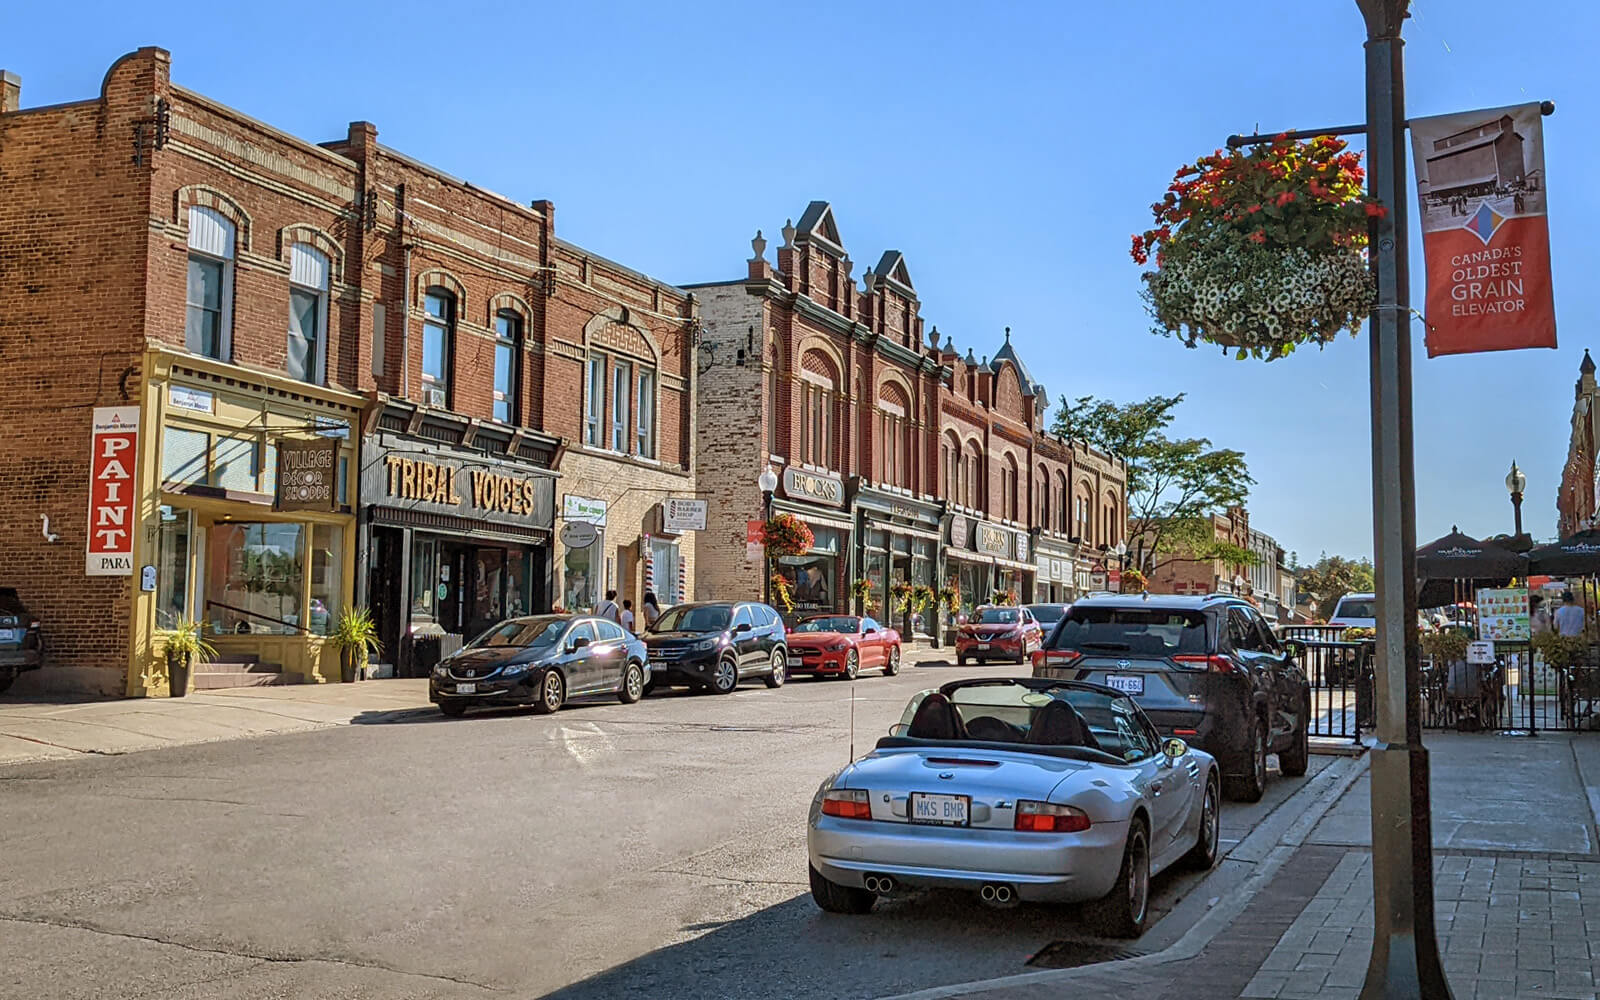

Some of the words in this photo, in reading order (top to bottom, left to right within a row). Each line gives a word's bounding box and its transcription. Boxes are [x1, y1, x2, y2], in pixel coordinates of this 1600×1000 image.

[1451, 246, 1522, 267] CANADA'S
[1451, 261, 1522, 282] OLDEST
[1451, 279, 1524, 301] GRAIN
[1452, 299, 1525, 317] ELEVATOR
[283, 449, 333, 472] VILLAGE
[96, 437, 131, 550] PAINT
[285, 485, 330, 500] SHOPPE
[384, 454, 462, 507] TRIBAL
[470, 469, 535, 517] VOICES
[793, 472, 837, 500] BROCK'S
[101, 557, 131, 570] PARA
[916, 801, 937, 816] MKS
[943, 801, 965, 818] BMR
